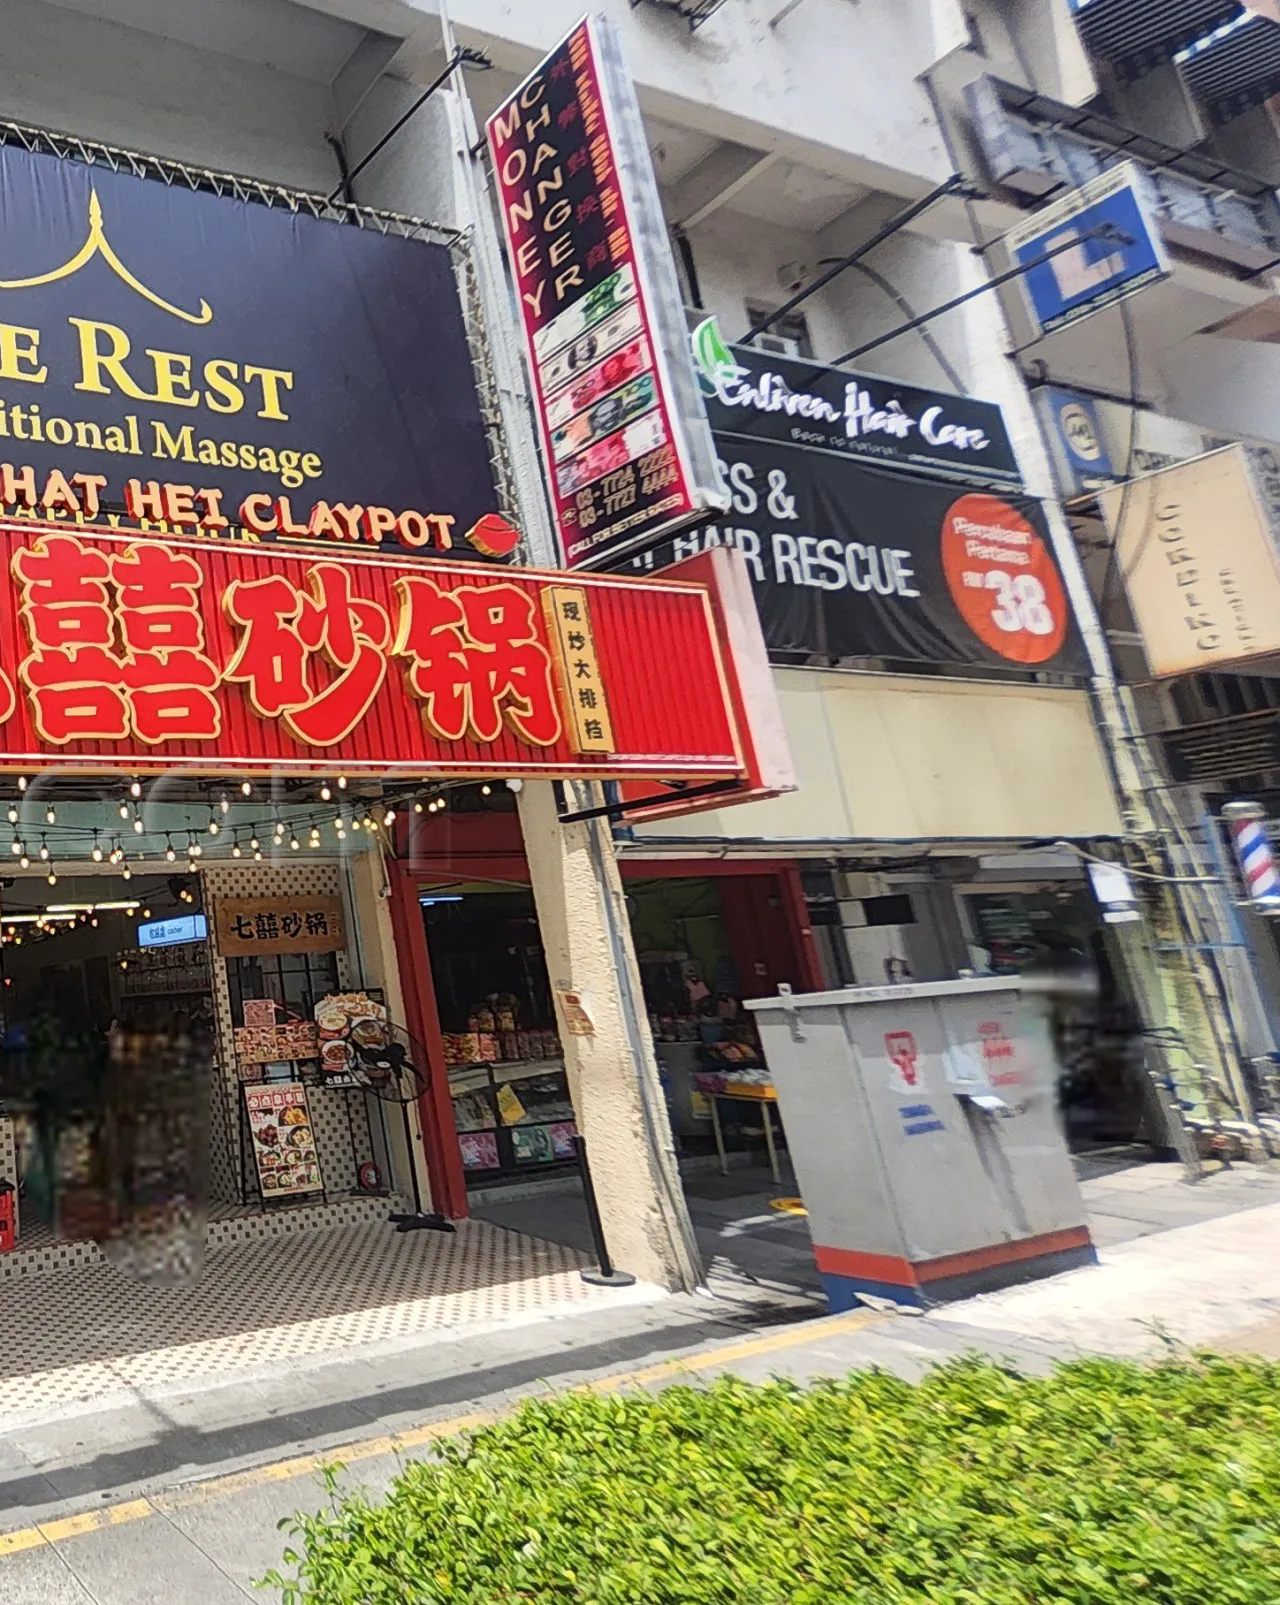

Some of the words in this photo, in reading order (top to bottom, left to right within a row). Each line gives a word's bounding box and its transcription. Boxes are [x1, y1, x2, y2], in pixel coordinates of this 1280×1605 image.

[68, 316, 294, 421] REST
[844, 381, 917, 438] Hair
[920, 406, 991, 450] Care
[151, 420, 324, 488] Massage
[124, 478, 229, 529] HEI
[239, 493, 456, 551] CLAYPOT
[767, 468, 799, 520] &
[771, 532, 921, 598] RESCUE
